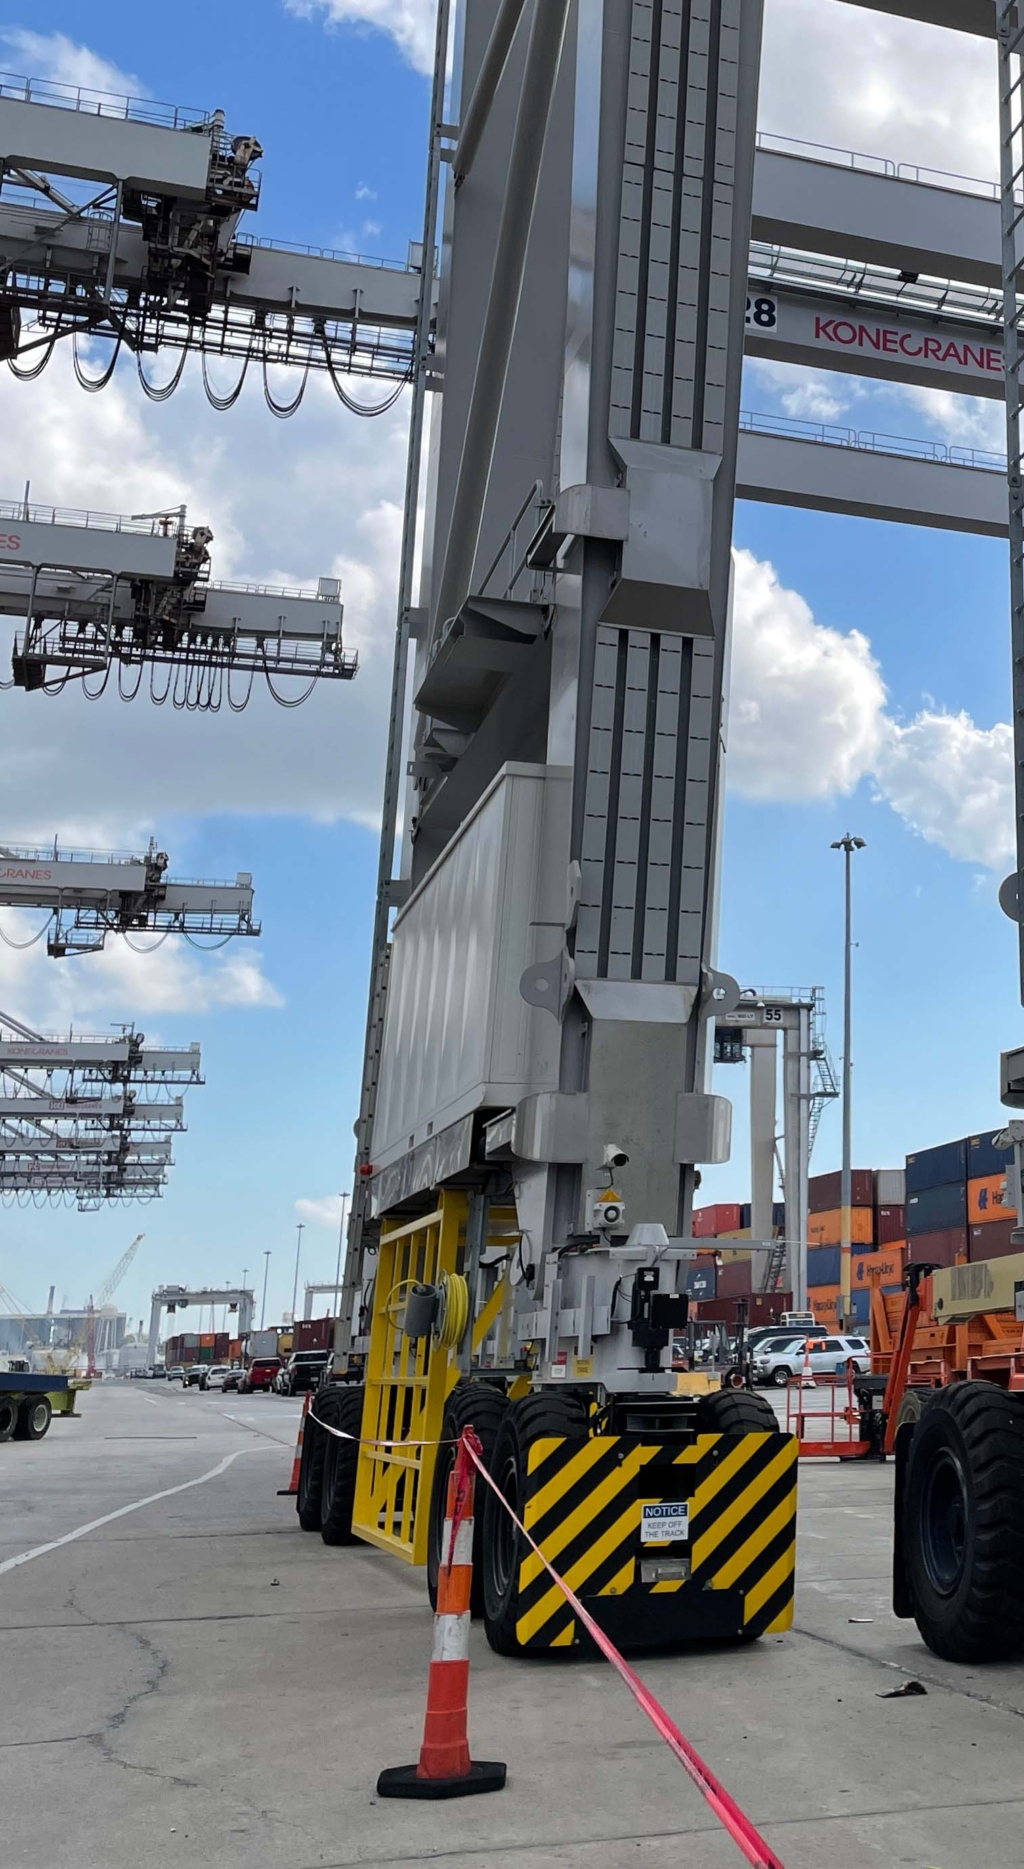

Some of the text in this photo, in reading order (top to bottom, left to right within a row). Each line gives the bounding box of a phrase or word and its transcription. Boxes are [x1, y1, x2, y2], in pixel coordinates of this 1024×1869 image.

[765, 1008, 781, 1021] 55
[645, 1506, 686, 1517] NOTICE
[647, 1520, 682, 1529] KEEP OFF
[660, 1529, 685, 1537] TRACK
